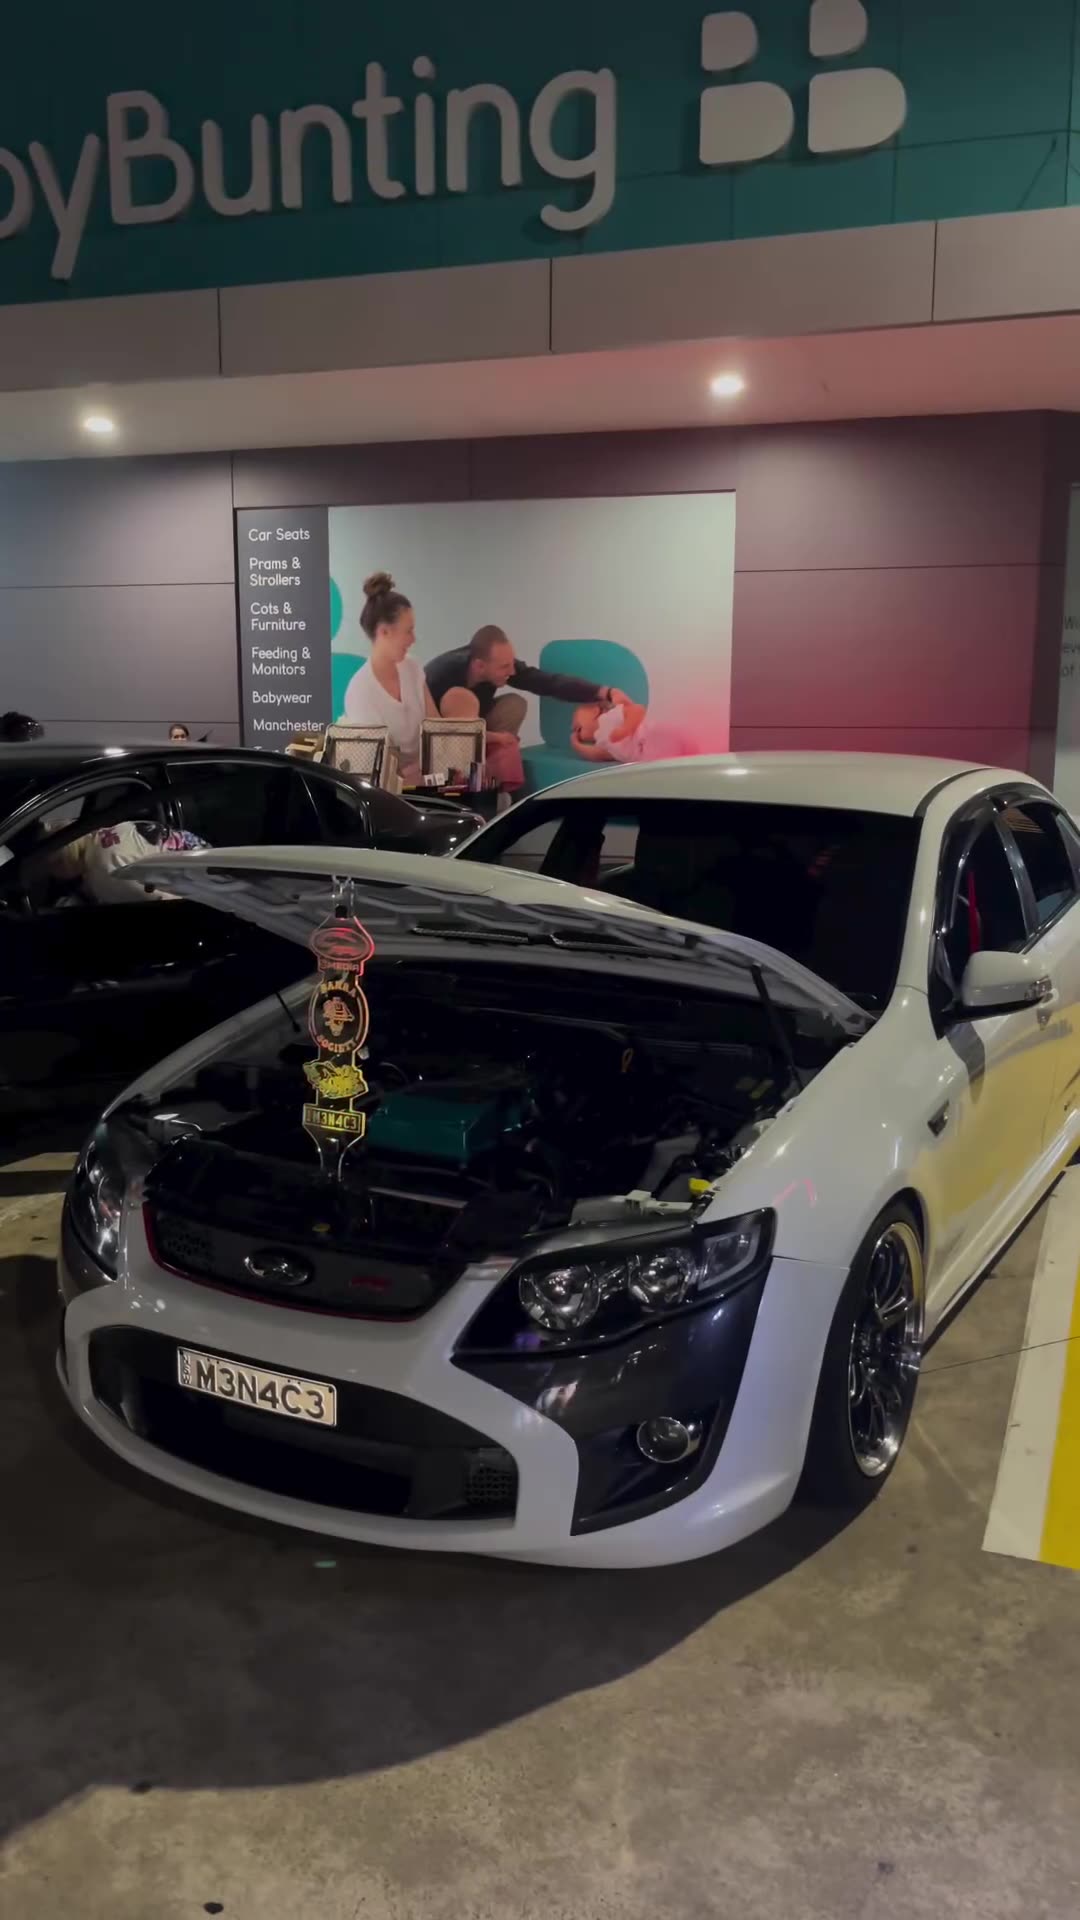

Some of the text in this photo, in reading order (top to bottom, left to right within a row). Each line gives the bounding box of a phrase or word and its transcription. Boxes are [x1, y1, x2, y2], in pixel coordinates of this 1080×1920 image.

[248, 527, 311, 542] Car Seats
[249, 556, 302, 571] Prams &
[249, 573, 301, 587] Strollers
[250, 601, 293, 616] Cots &
[250, 618, 307, 631] Furniture
[251, 646, 312, 663] Feeding &
[251, 663, 306, 676] Monitors
[252, 691, 313, 706] Babywear
[253, 718, 325, 733] Manchester
[196, 1359, 325, 1420] M3N4C3
